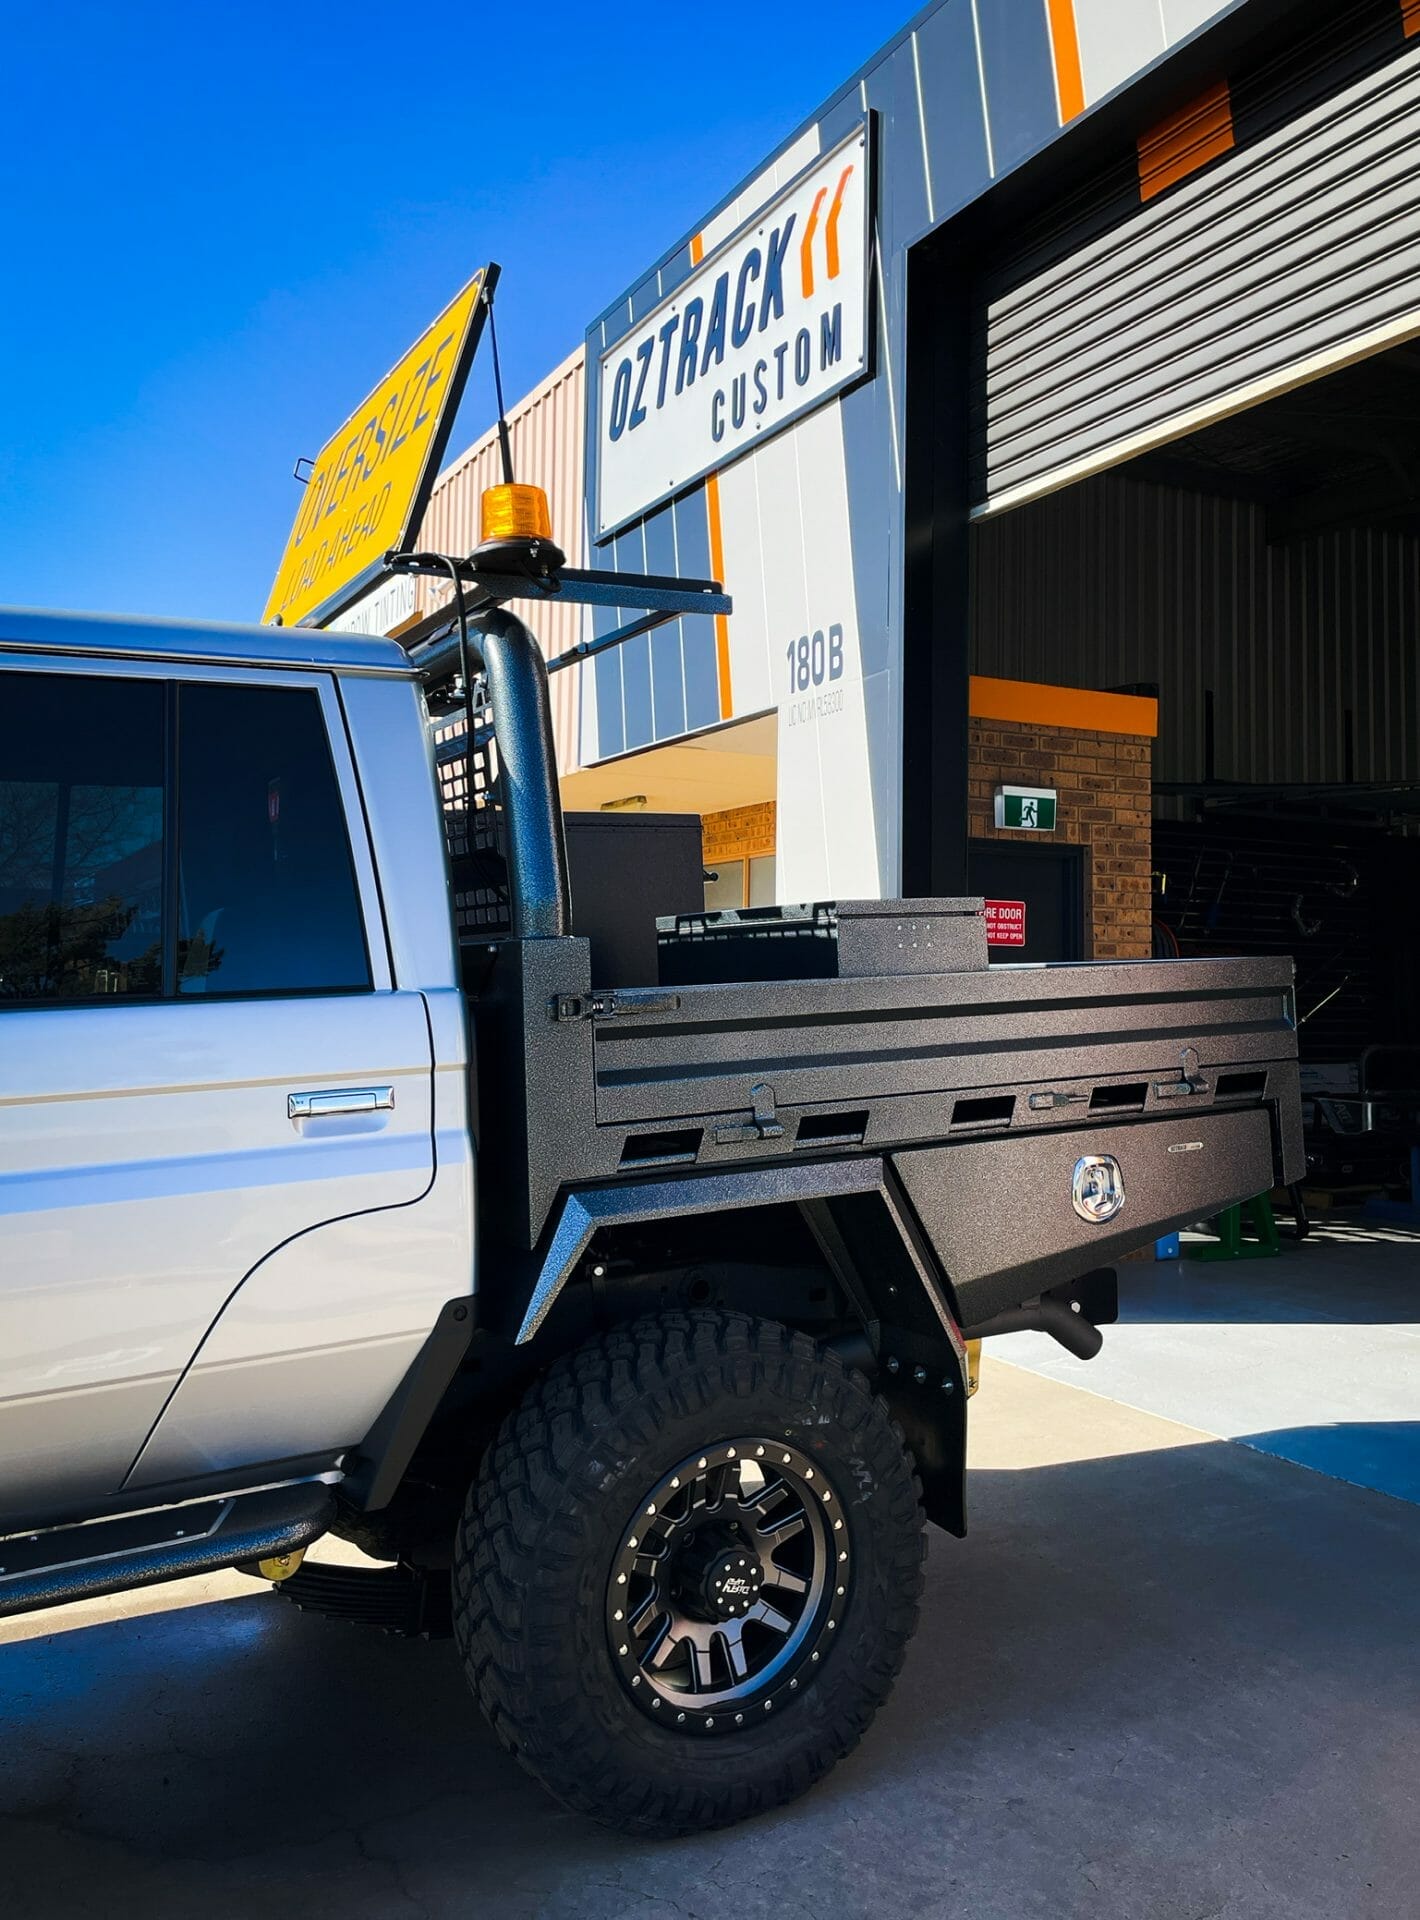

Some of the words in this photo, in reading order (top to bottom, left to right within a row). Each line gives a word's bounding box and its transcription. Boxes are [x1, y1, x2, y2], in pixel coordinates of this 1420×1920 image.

[609, 213, 797, 442] OZTRACK
[711, 302, 842, 443] CUSTOM
[294, 332, 456, 548] OVERSIZE
[281, 540, 329, 612] LOAD
[322, 481, 392, 573] AHEAD
[786, 622, 844, 694] 180B
[999, 908, 1022, 919] DOOR
